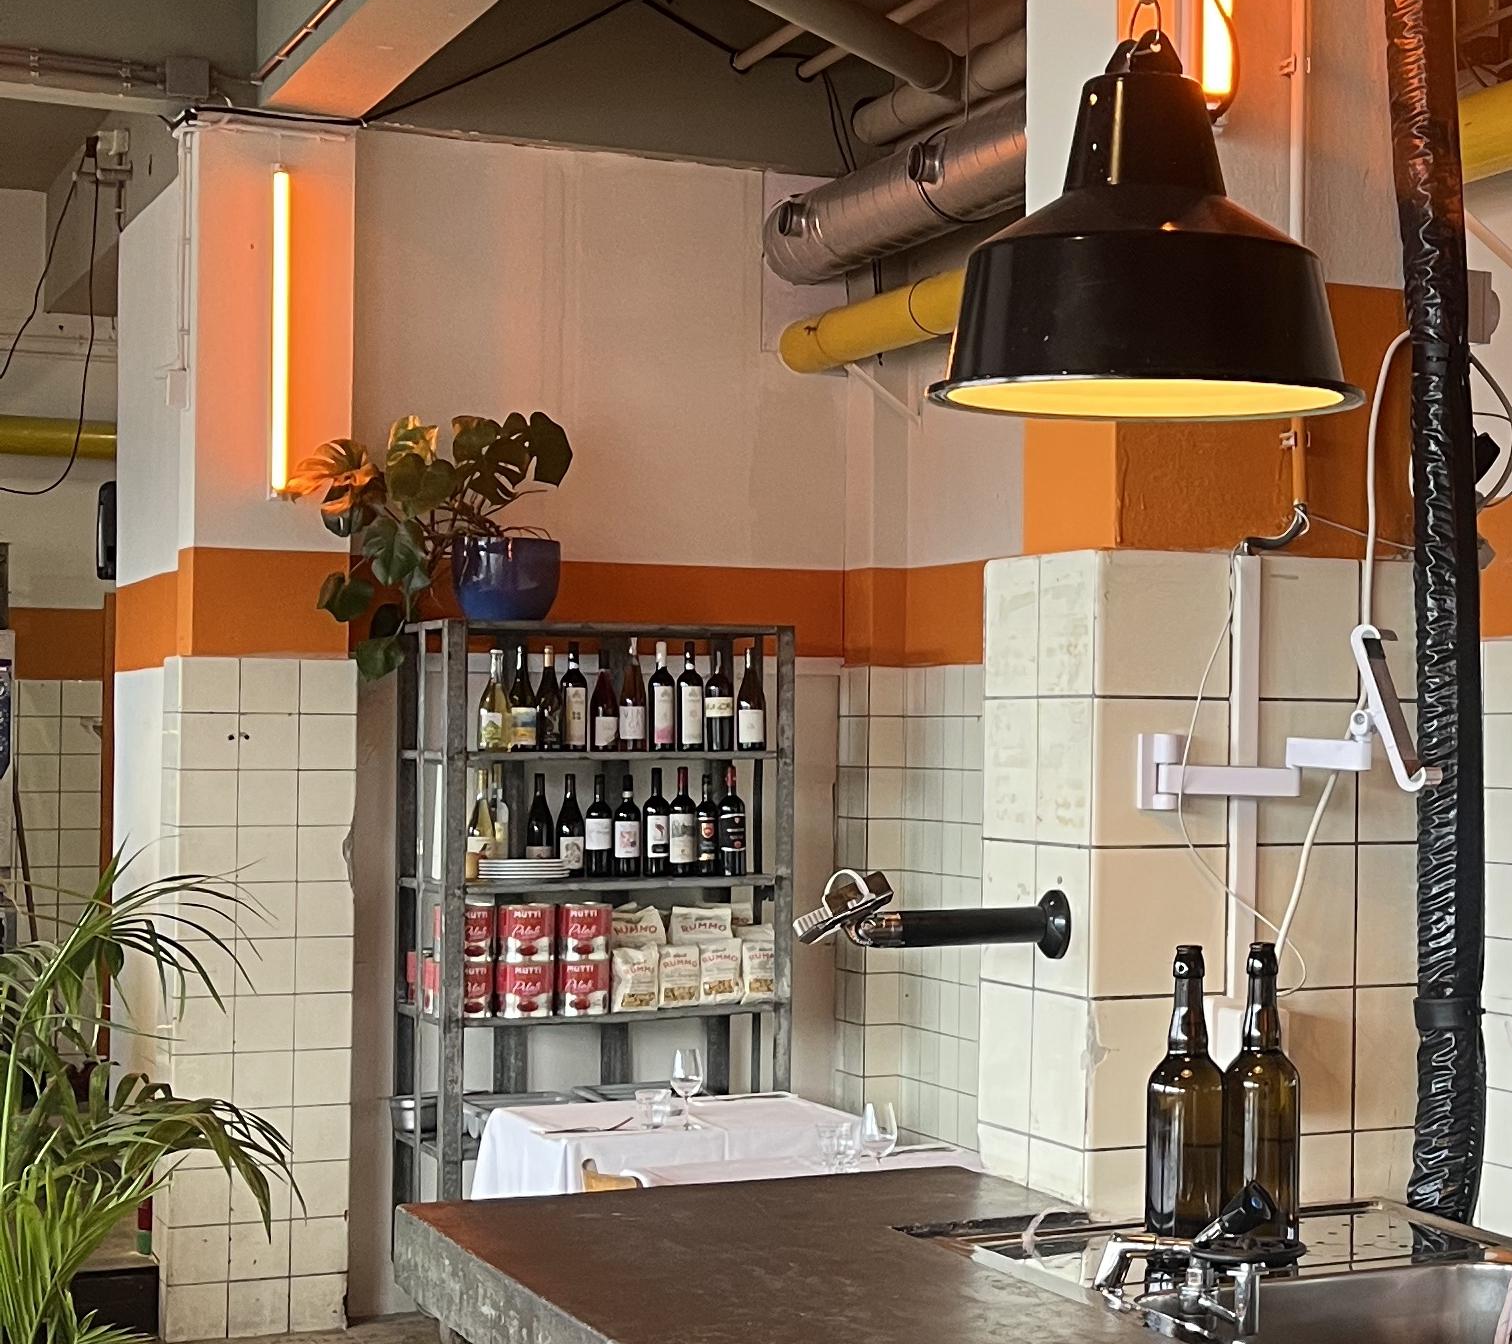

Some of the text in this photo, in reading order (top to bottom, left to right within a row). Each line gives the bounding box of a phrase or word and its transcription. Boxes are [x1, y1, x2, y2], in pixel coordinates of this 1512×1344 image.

[513, 910, 541, 919] MUTTI
[570, 909, 597, 918] MUTTI
[680, 921, 727, 933] RUMMO
[702, 954, 738, 963] RUMMO
[567, 965, 593, 973] MUTTI
[663, 960, 698, 969] RUMMO
[465, 967, 486, 975] UTTI
